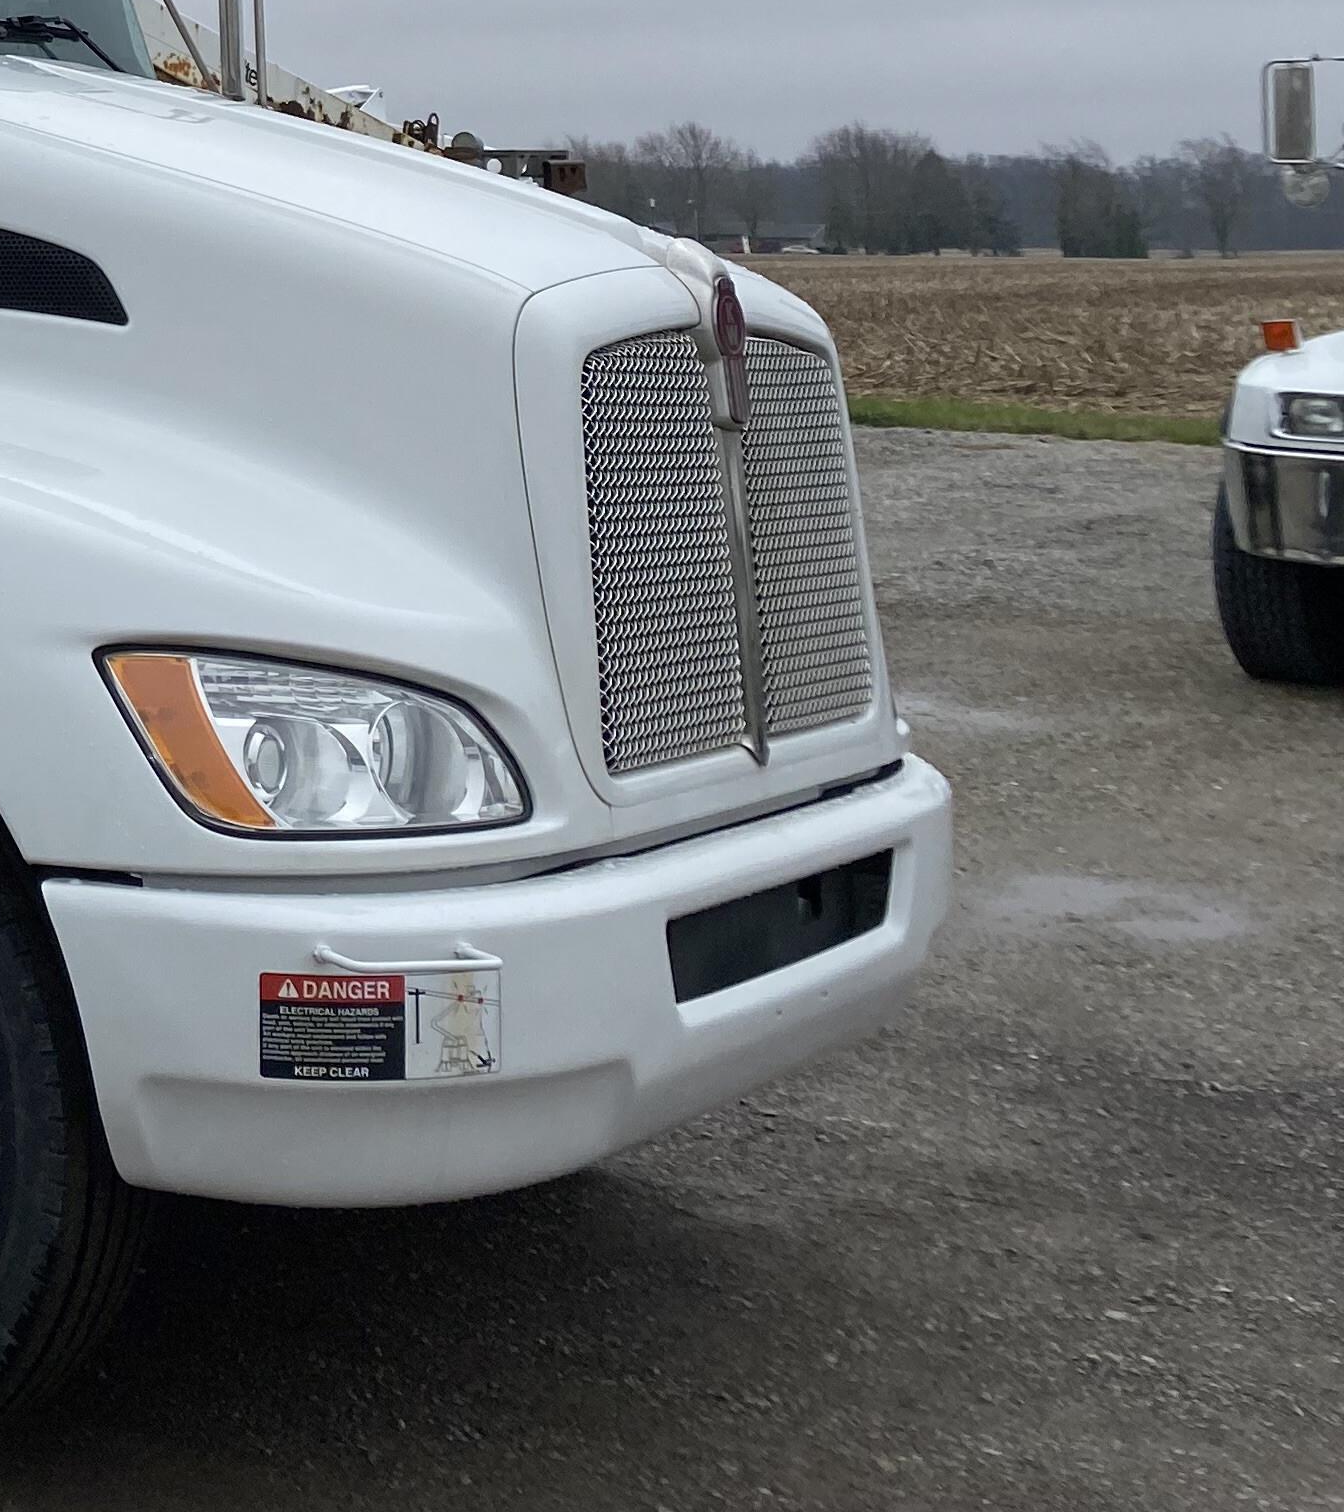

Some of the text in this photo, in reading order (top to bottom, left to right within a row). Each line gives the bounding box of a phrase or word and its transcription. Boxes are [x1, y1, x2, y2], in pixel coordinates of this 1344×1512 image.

[303, 980, 390, 999] DANGER
[279, 1006, 379, 1016] ELECTRICAL HAZARDS
[294, 1066, 370, 1078] KEEP CLEAR
